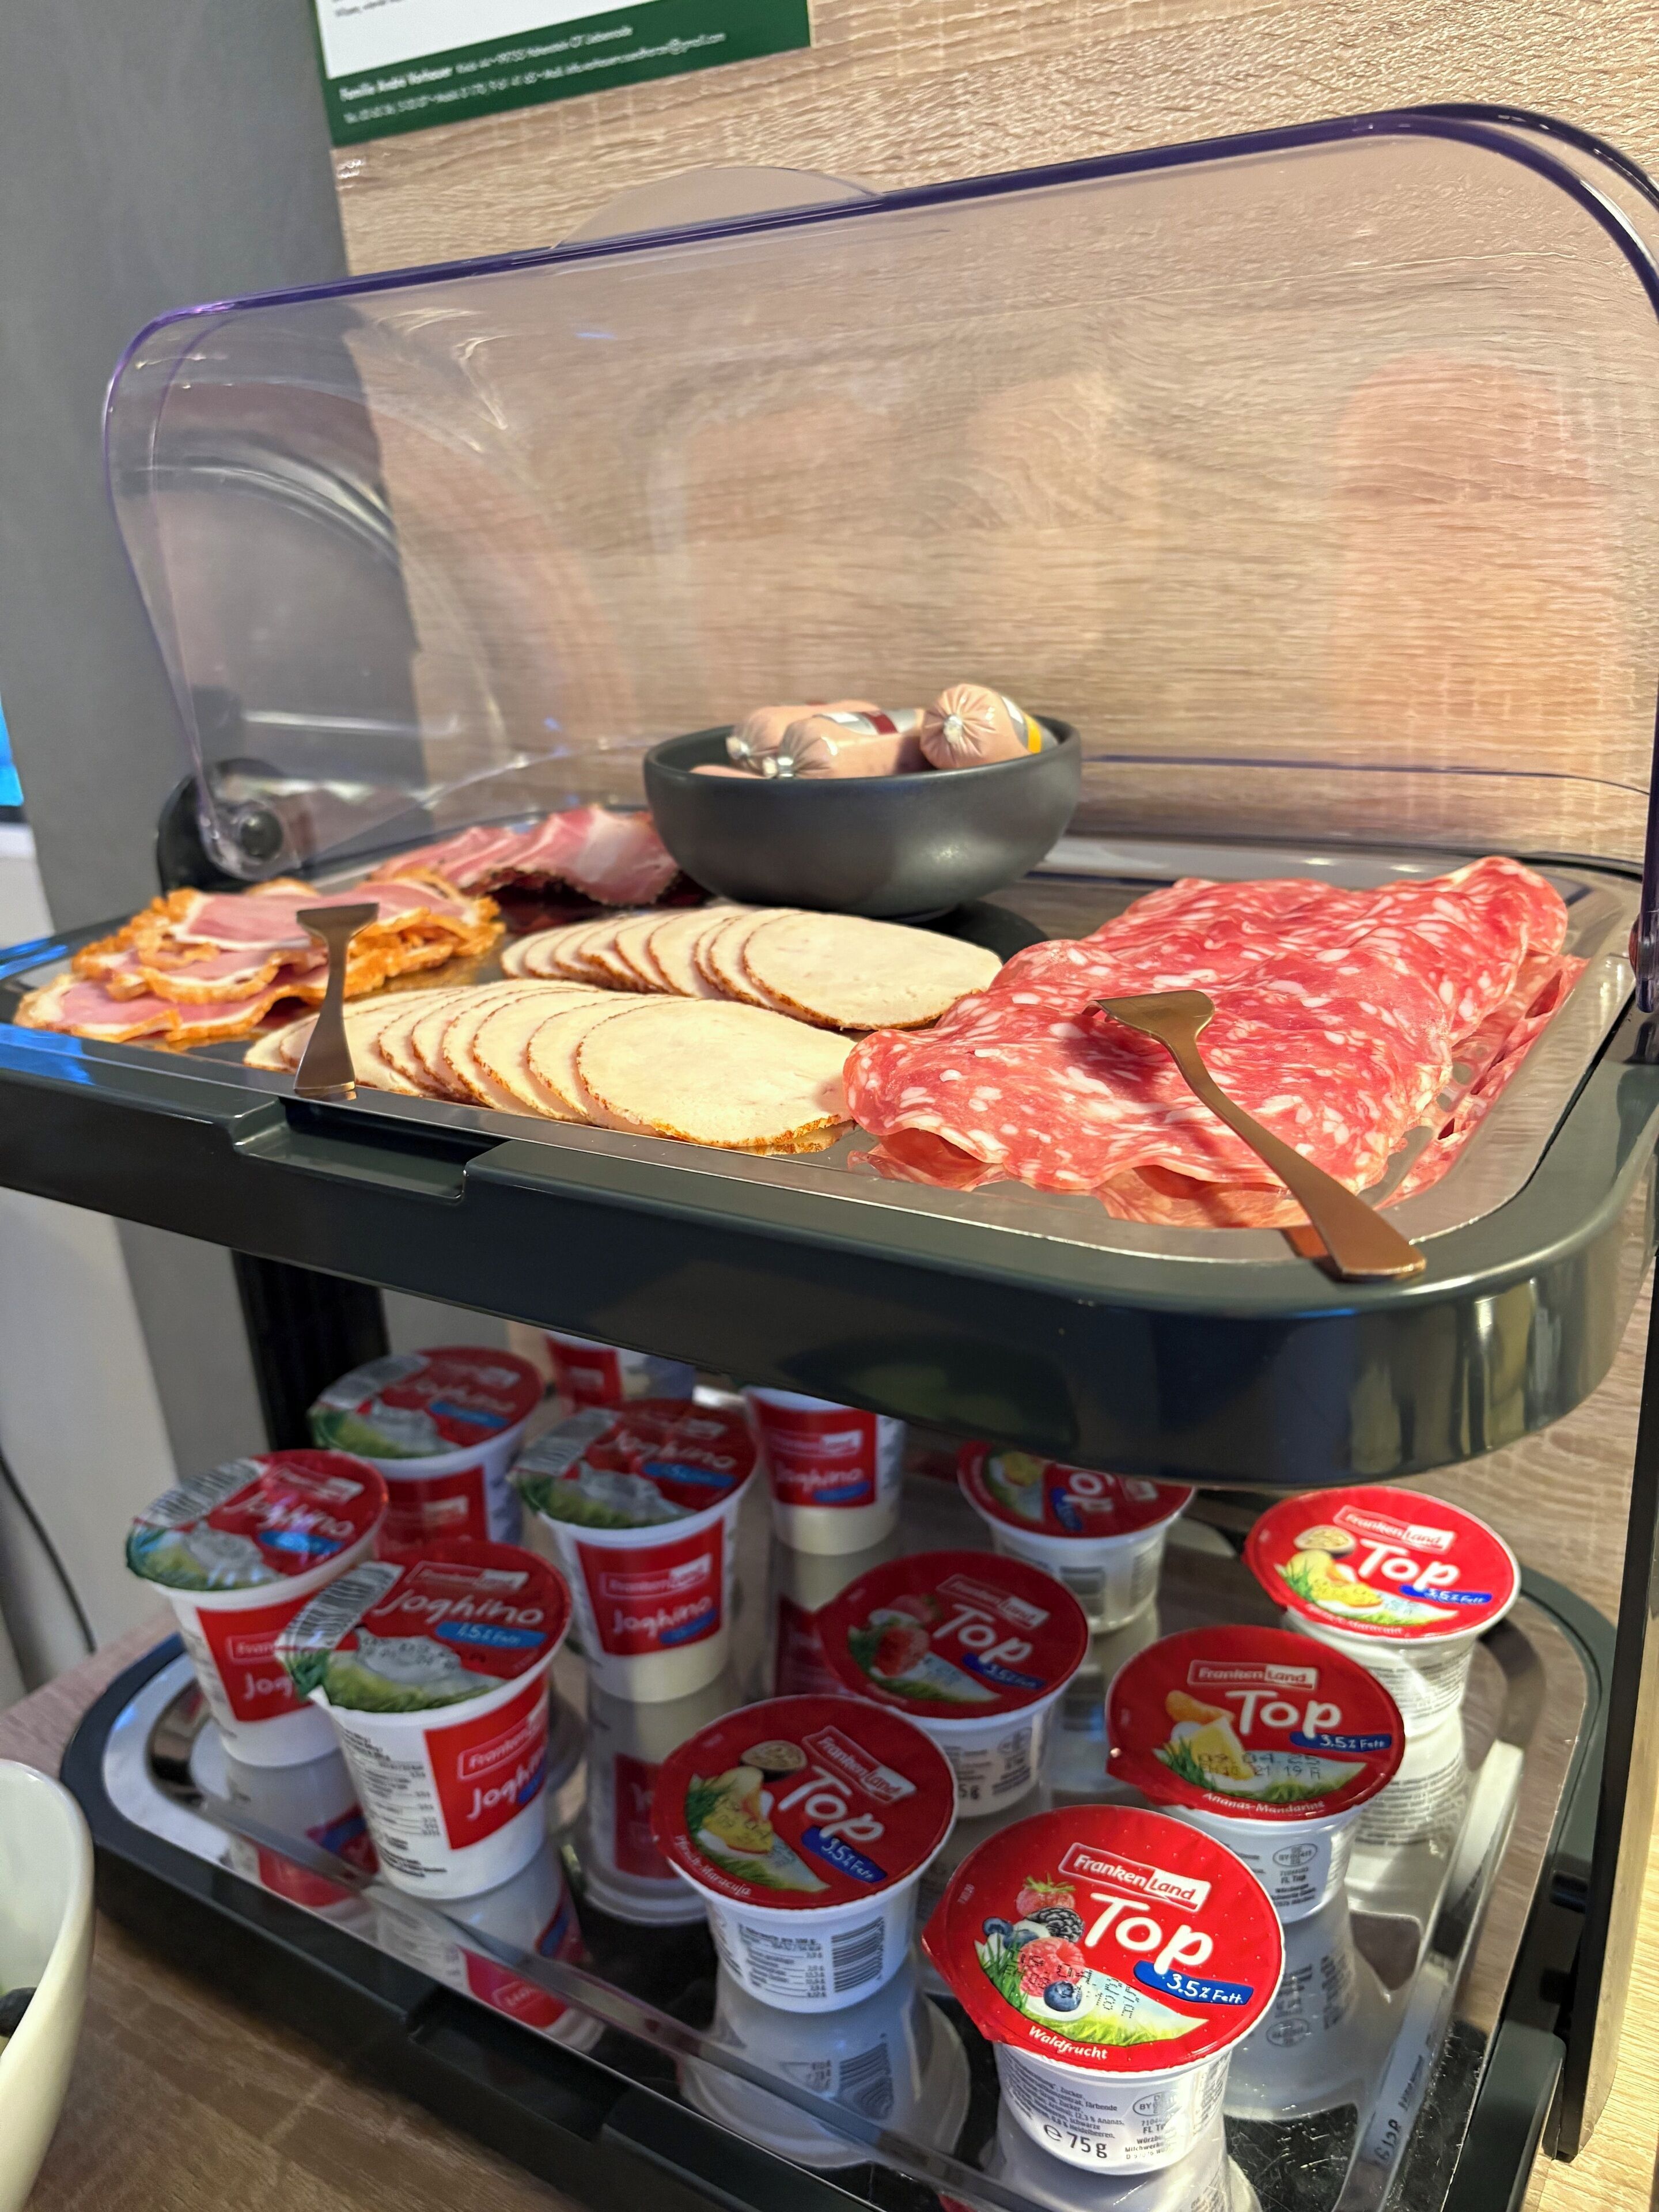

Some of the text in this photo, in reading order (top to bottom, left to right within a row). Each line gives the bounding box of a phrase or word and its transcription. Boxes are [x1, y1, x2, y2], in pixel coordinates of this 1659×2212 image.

[1357, 1537, 1461, 1591] Top
[374, 1589, 544, 1626] Joghino
[933, 1604, 1033, 1662] Top
[1199, 1667, 1306, 1681] FrankenLand
[1225, 1690, 1342, 1738] Top
[1360, 1739, 1385, 1749] Fett
[779, 1766, 884, 1840] Top
[1074, 1854, 1196, 1901] FrankenLand
[1085, 1892, 1213, 1975] Top
[1029, 2025, 1108, 2060] Waldfrucht
